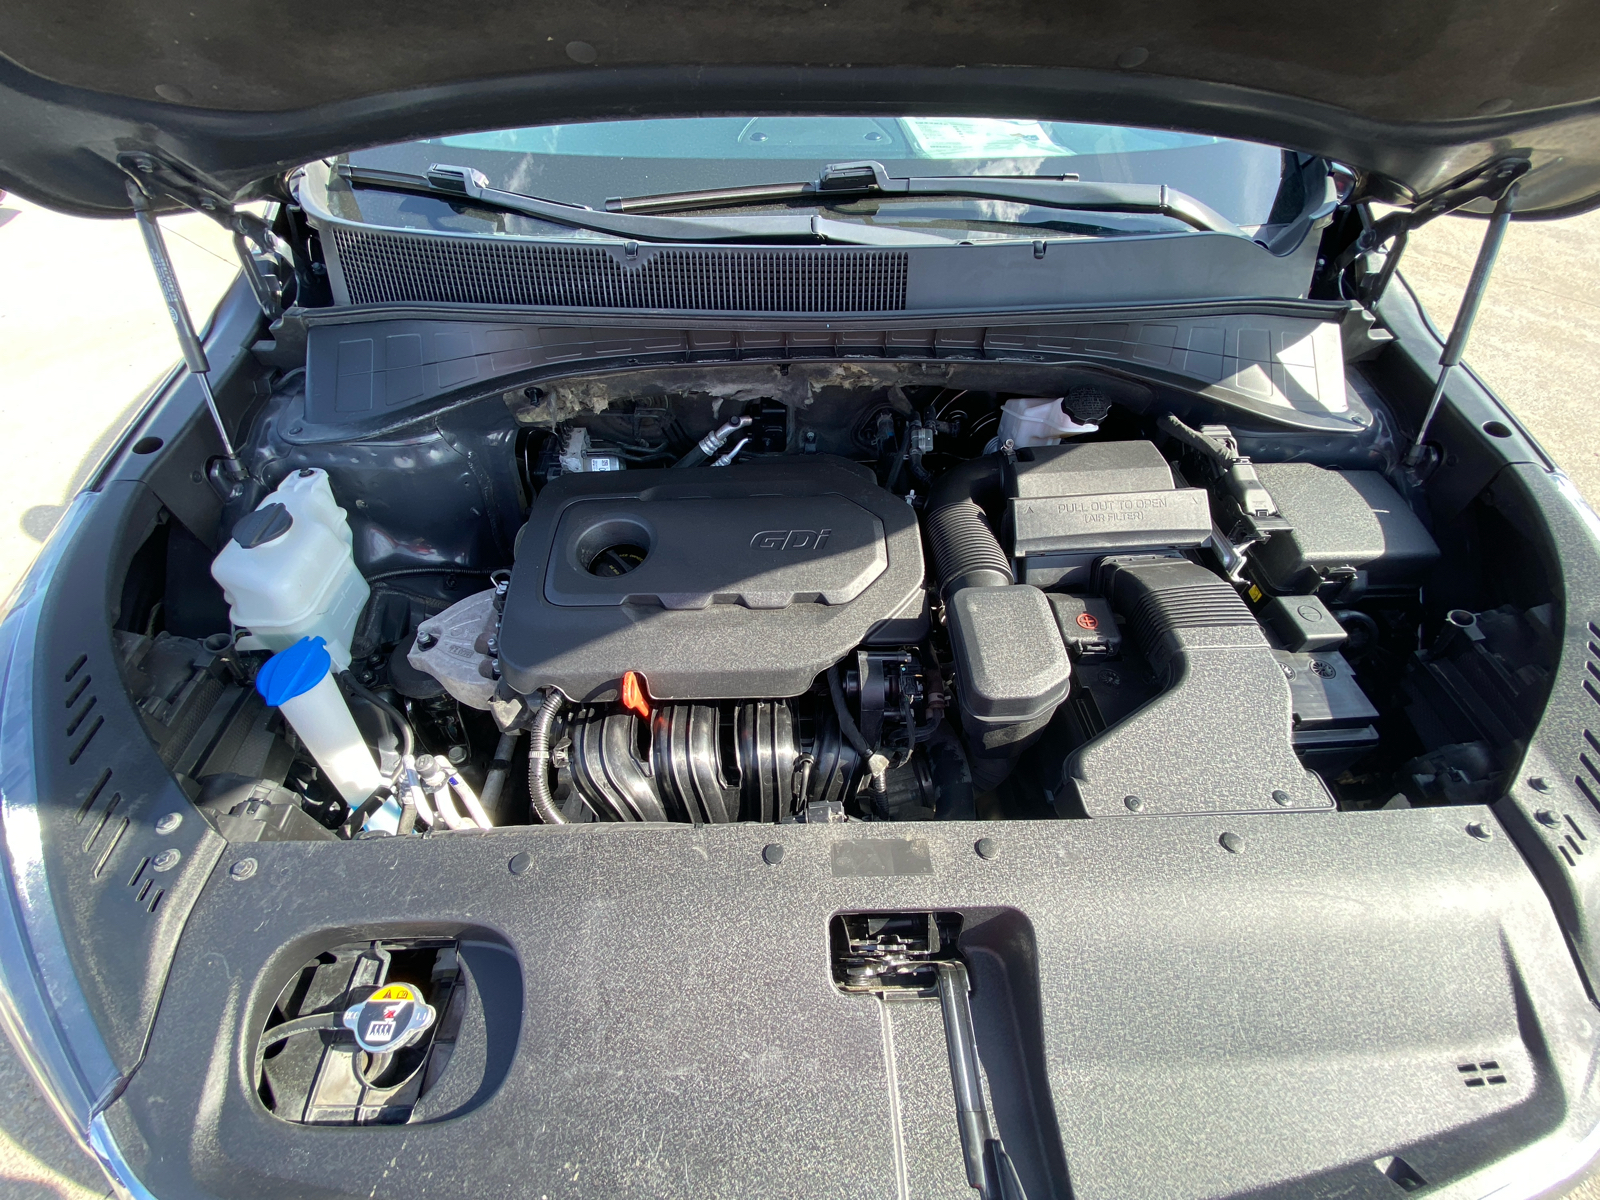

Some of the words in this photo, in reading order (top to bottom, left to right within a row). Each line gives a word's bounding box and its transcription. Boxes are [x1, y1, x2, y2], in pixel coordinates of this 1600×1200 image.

[1057, 502, 1088, 514] PULL
[1090, 500, 1114, 512] OUT
[1119, 499, 1133, 511] TO
[1136, 497, 1168, 509] OPEN
[1084, 513, 1105, 523] (AIR
[1107, 511, 1144, 521] FILTER)
[750, 528, 832, 551] GDi
